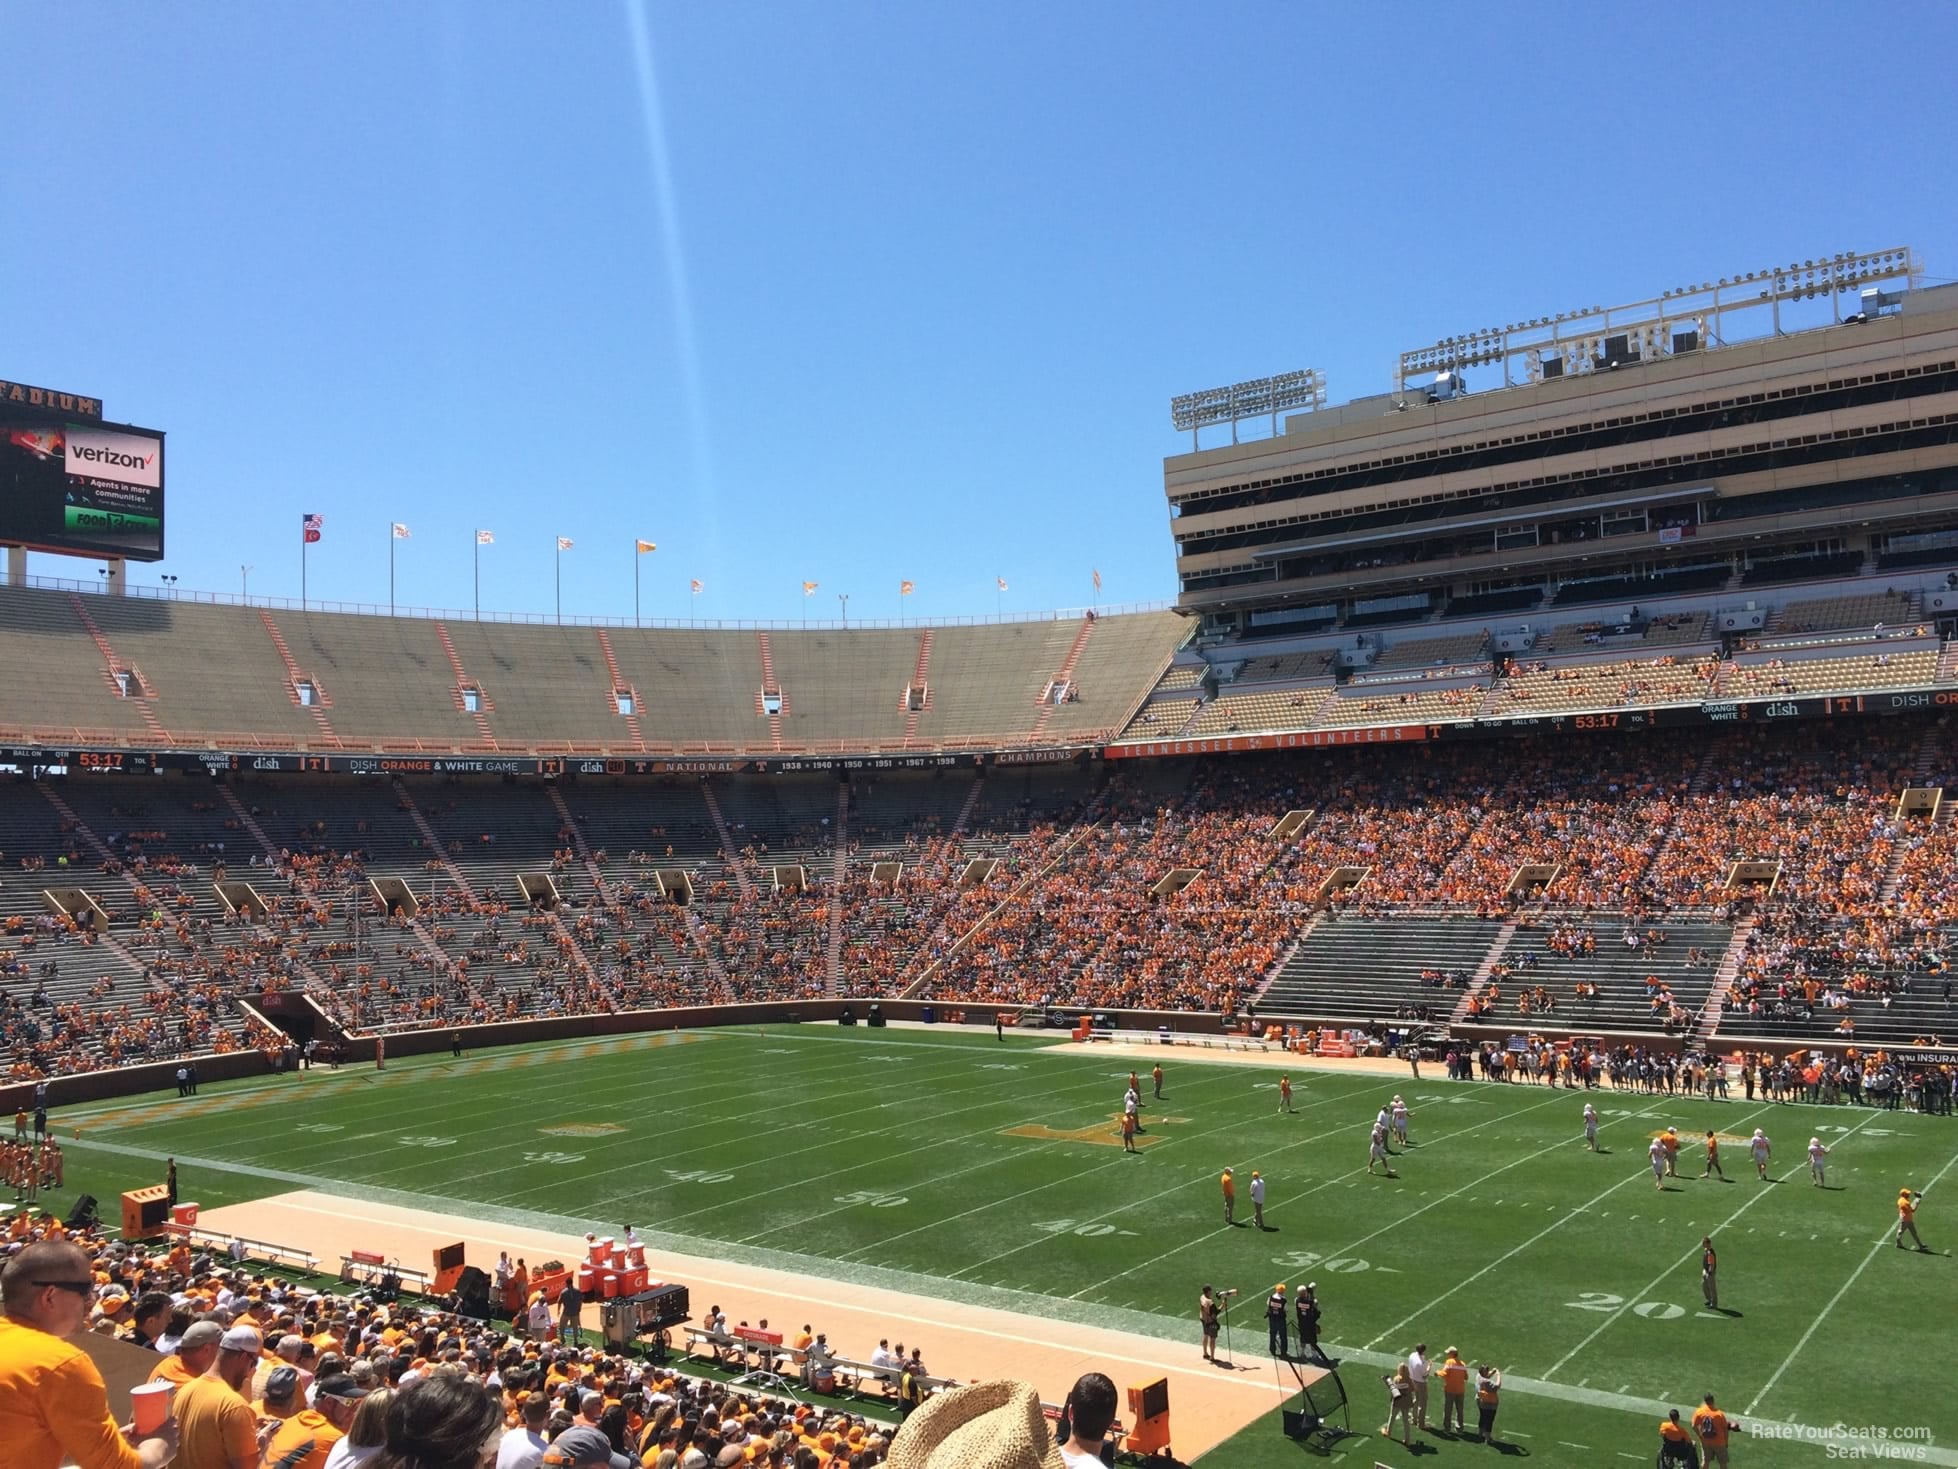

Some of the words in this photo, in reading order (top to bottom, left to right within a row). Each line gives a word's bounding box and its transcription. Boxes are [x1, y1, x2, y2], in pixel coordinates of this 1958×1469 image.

[72, 445, 145, 470] verizon
[90, 479, 119, 490] Agents
[121, 483, 129, 491] in
[130, 485, 151, 495] more
[95, 490, 146, 503] communities
[1837, 697, 1853, 712] T
[1891, 694, 1930, 707] DISH
[1701, 704, 1737, 713] ORANGE
[1766, 702, 1798, 718] dish
[1551, 716, 1565, 724] QTR
[1575, 714, 1619, 729] 53:17
[1710, 712, 1738, 720] WHITE
[1429, 725, 1441, 738] T
[1123, 739, 1234, 757] TENNESSEE
[1276, 729, 1402, 748] VOLUNTEERS
[80, 753, 123, 766] 53:17
[134, 757, 146, 765] TOL
[198, 754, 230, 762] ORANGE
[973, 754, 984, 765] T
[1000, 751, 1071, 762] CHAMPIONS
[253, 756, 280, 770] dish
[310, 758, 320, 770] T
[350, 759, 377, 770] DISH
[380, 760, 431, 771] ORANGE
[434, 760, 442, 771] &
[445, 761, 483, 772] WHITE
[485, 762, 519, 772] GAME
[546, 761, 556, 772] T
[580, 761, 603, 773] dish
[635, 761, 647, 773] T
[666, 762, 733, 771] NATIONAL
[756, 761, 767, 773] T
[782, 762, 802, 770] 1938
[813, 761, 832, 769] 1940
[844, 760, 863, 769] 1950
[875, 760, 892, 768] 1951
[906, 759, 924, 767] 1967
[936, 758, 956, 766] 1998
[262, 995, 281, 1006] dish
[833, 1190, 909, 1208] 50
[186, 1210, 195, 1221] G
[1031, 1219, 1116, 1236] 40
[1271, 1251, 1370, 1273] 30
[634, 1276, 642, 1287] G
[1564, 1292, 1686, 1320] 20
